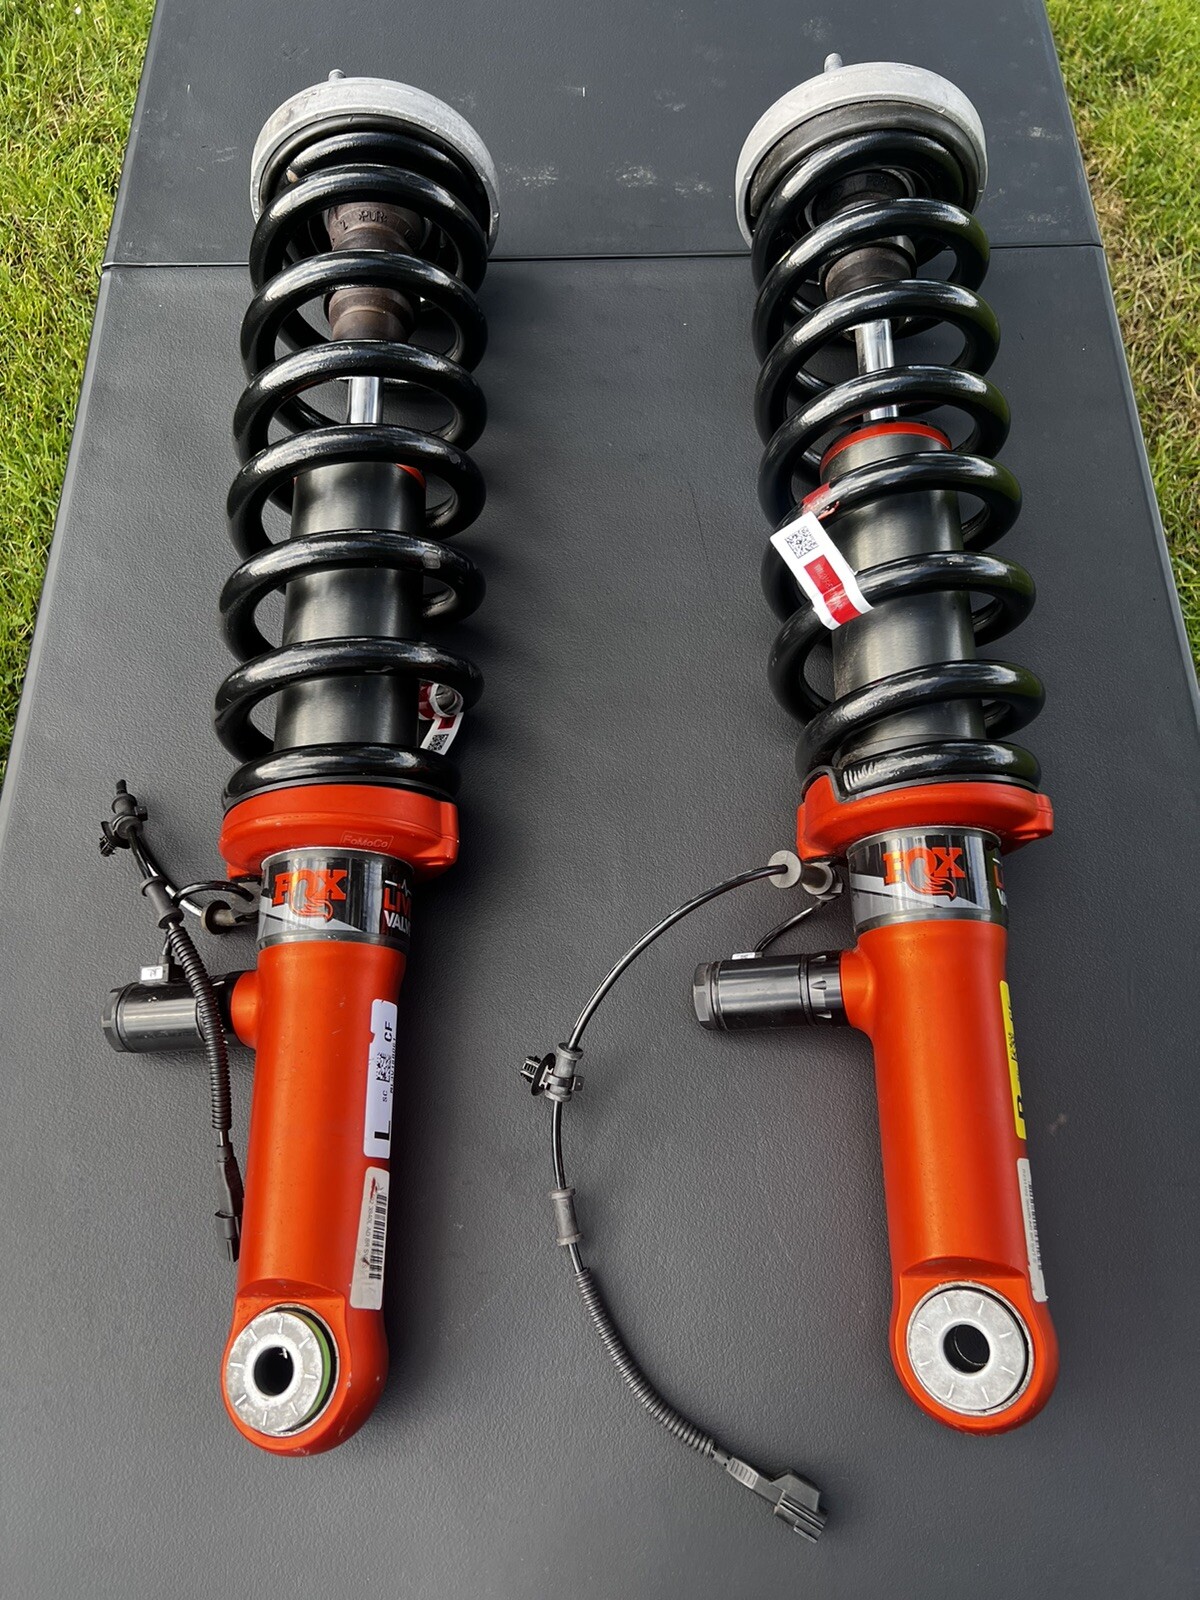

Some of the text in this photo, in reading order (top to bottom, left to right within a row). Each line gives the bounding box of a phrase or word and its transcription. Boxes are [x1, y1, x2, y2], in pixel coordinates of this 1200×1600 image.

[342, 835, 389, 849] FoMoCo
[883, 847, 966, 901] FOX
[272, 868, 348, 920] FOX
[383, 1020, 394, 1043] CF
[374, 1120, 391, 1141] L
